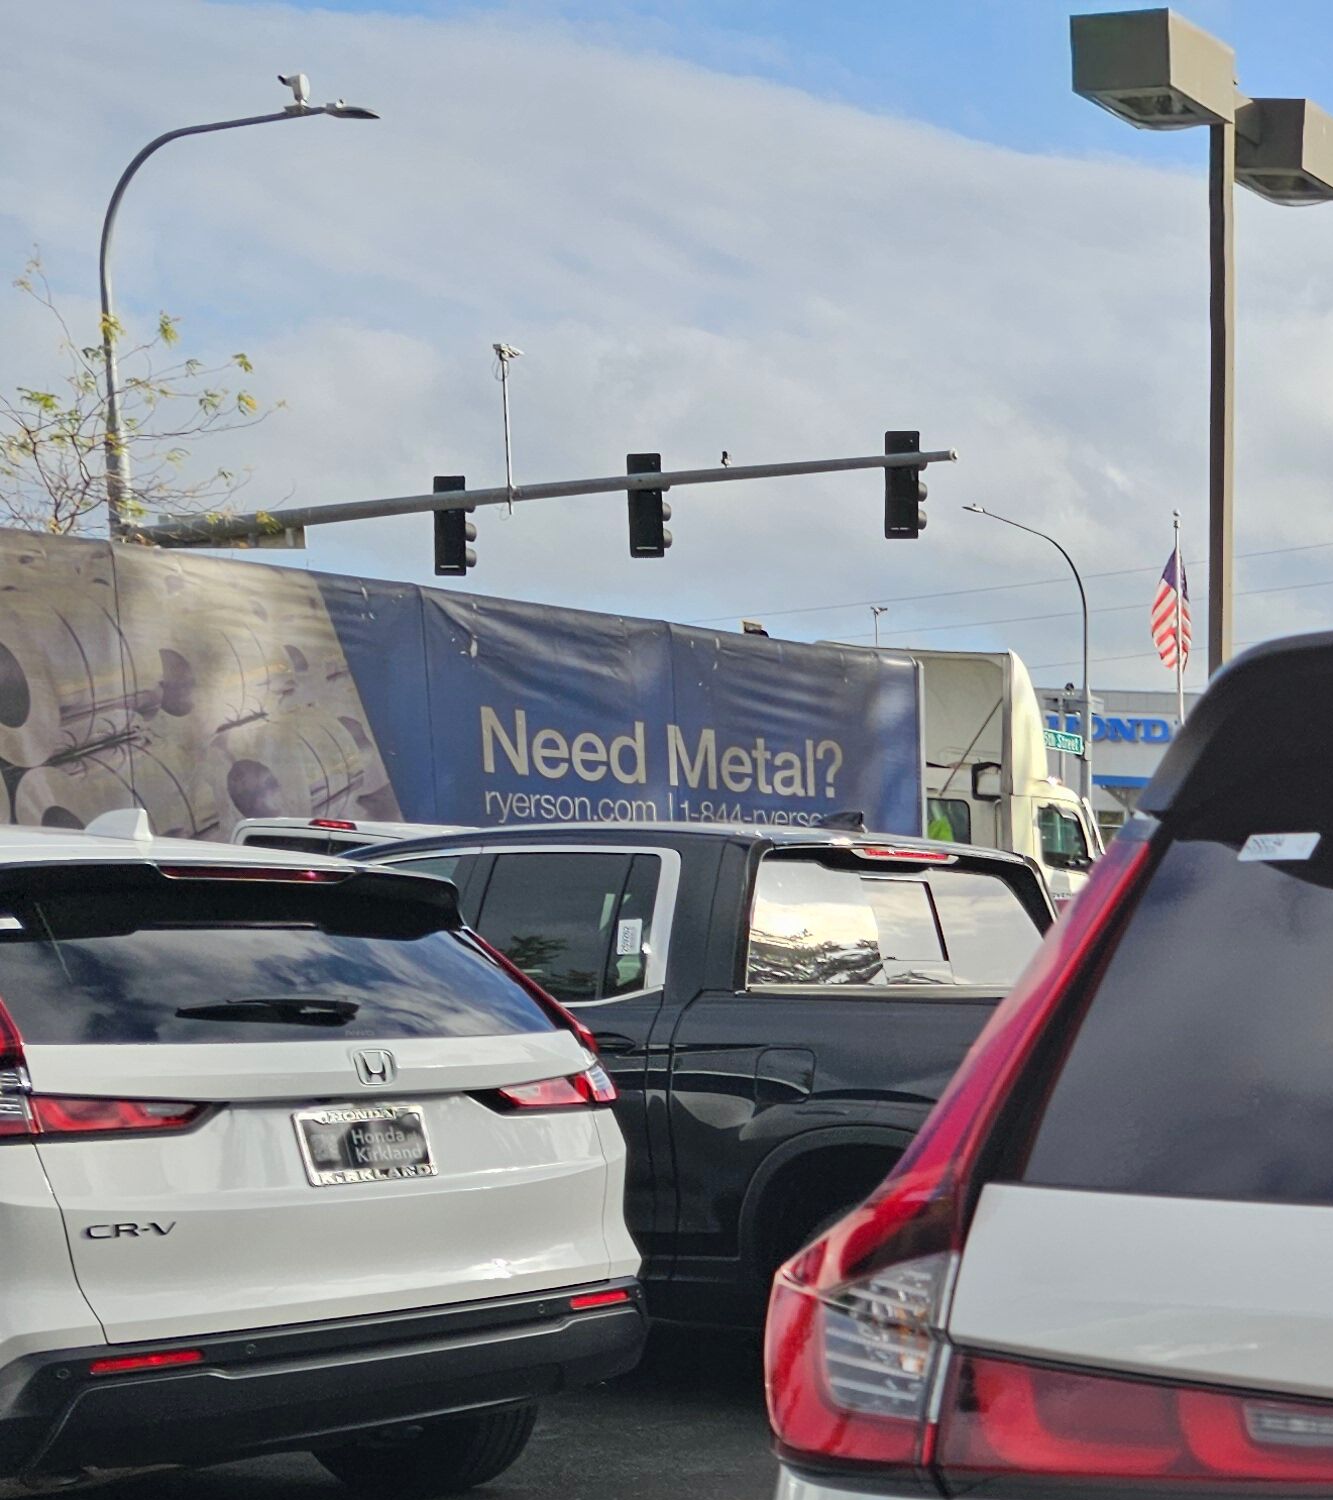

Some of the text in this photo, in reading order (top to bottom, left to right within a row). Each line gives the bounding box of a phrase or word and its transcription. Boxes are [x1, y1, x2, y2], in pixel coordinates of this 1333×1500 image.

[1046, 714, 1173, 743] HOND
[479, 706, 843, 798] Need Metal?
[1056, 734, 1079, 751] Street
[484, 790, 828, 827] ryerson.com 1-844-ryerso
[327, 1108, 395, 1123] HONDA
[351, 1126, 406, 1145] Honda
[354, 1143, 423, 1163] Kirkland
[319, 1164, 432, 1184] KIRKLAND
[85, 1221, 177, 1240] CR-V
